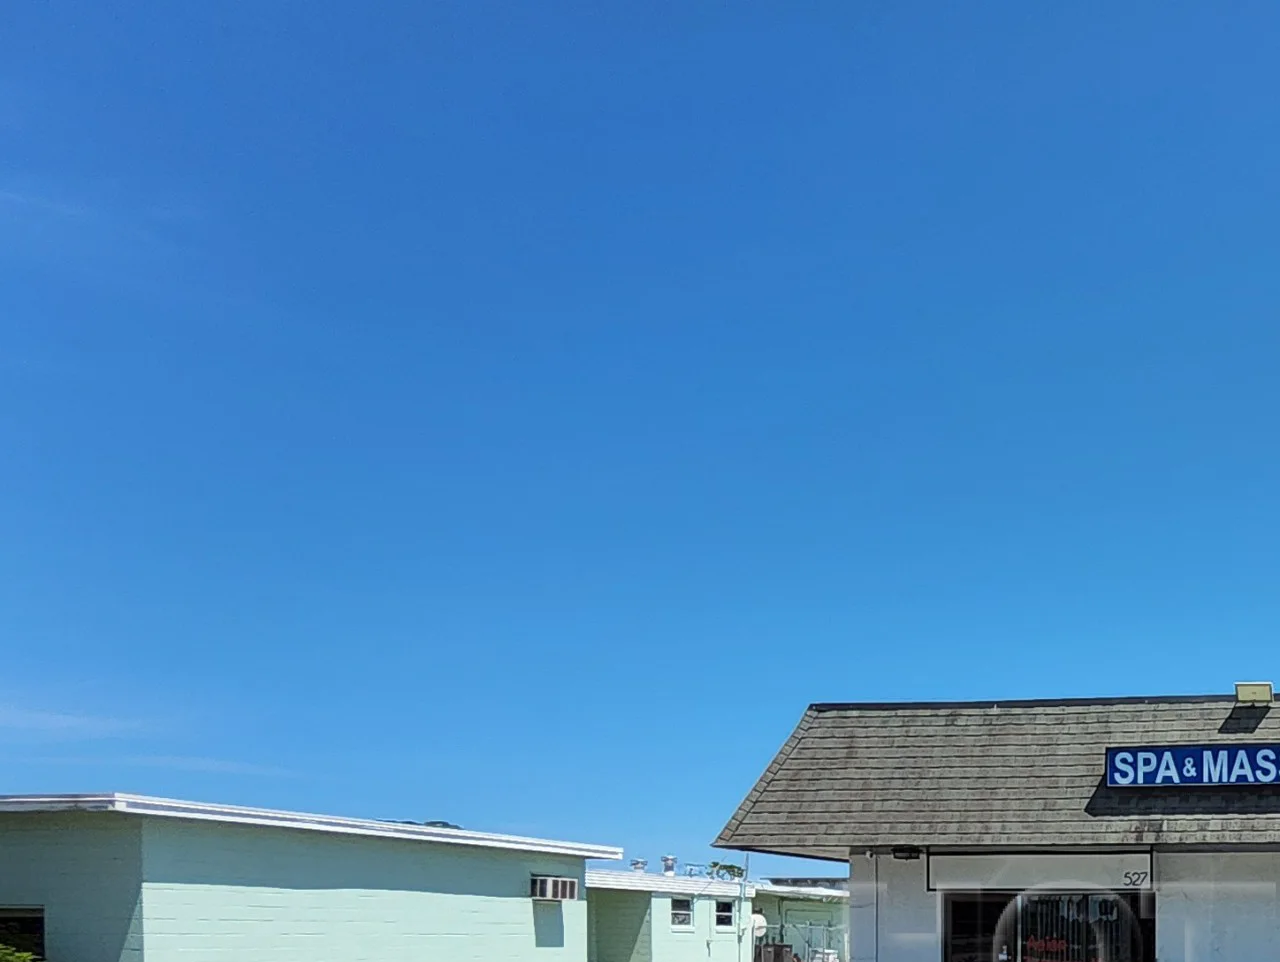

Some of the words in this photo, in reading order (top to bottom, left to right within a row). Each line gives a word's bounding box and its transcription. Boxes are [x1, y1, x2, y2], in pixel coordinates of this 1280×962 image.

[1113, 751, 1180, 785] SPA
[1183, 757, 1197, 777] &
[1123, 872, 1148, 886] 527
